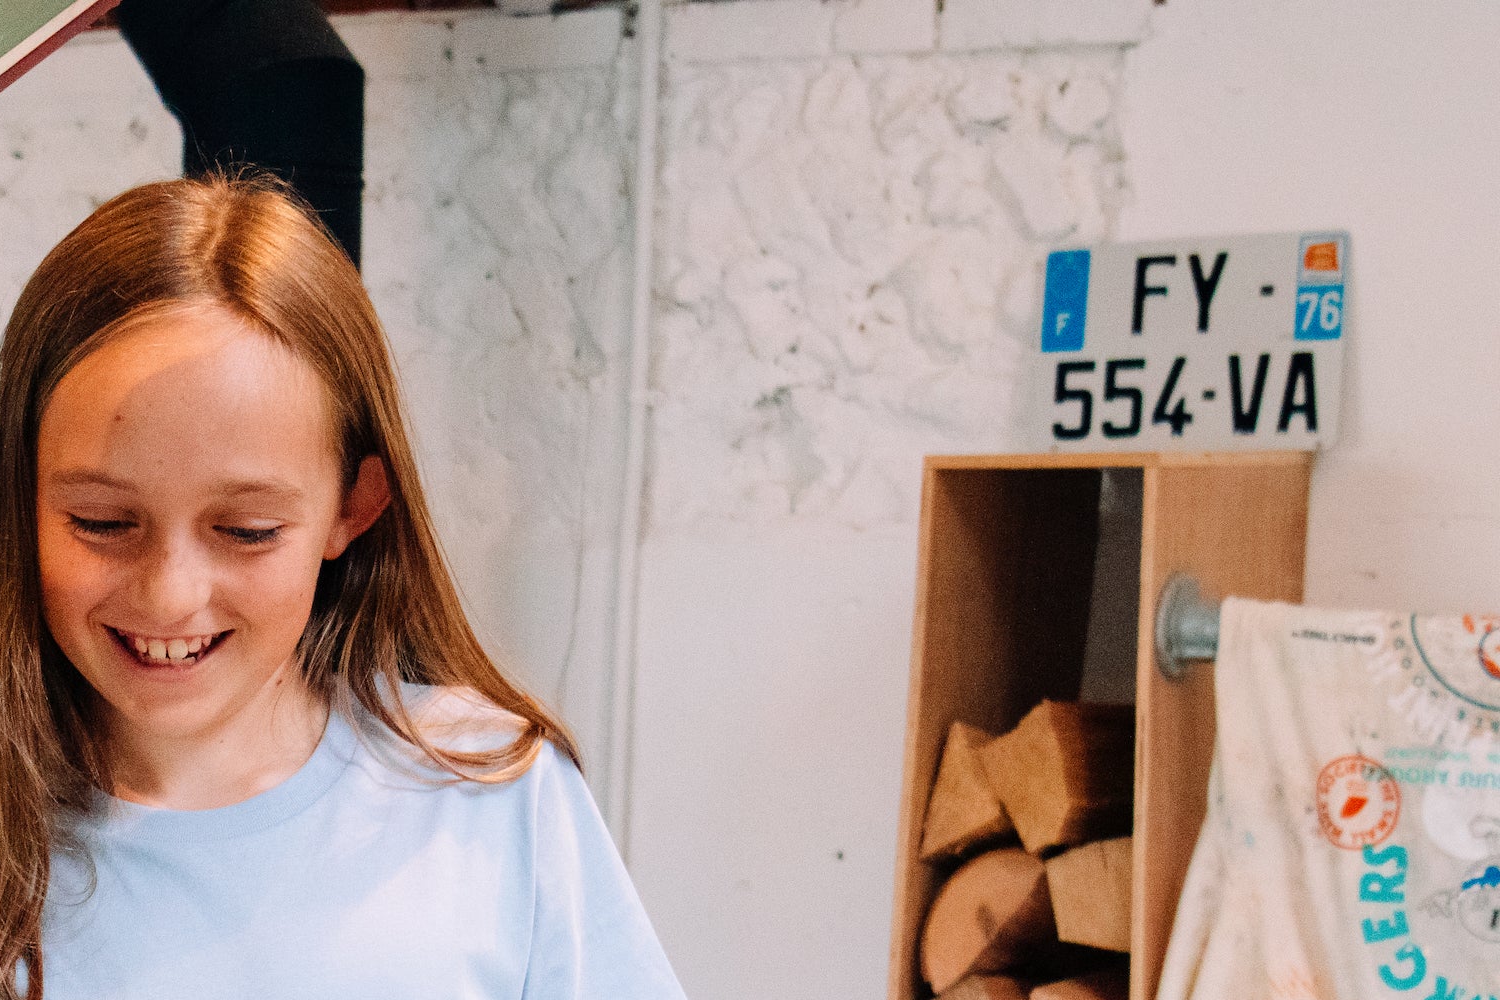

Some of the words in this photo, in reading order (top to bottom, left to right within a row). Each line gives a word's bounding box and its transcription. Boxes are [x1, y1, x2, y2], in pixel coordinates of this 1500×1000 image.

[1056, 313, 1070, 336] F
[1299, 291, 1340, 331] 76
[1052, 352, 1318, 441] 554-VA
